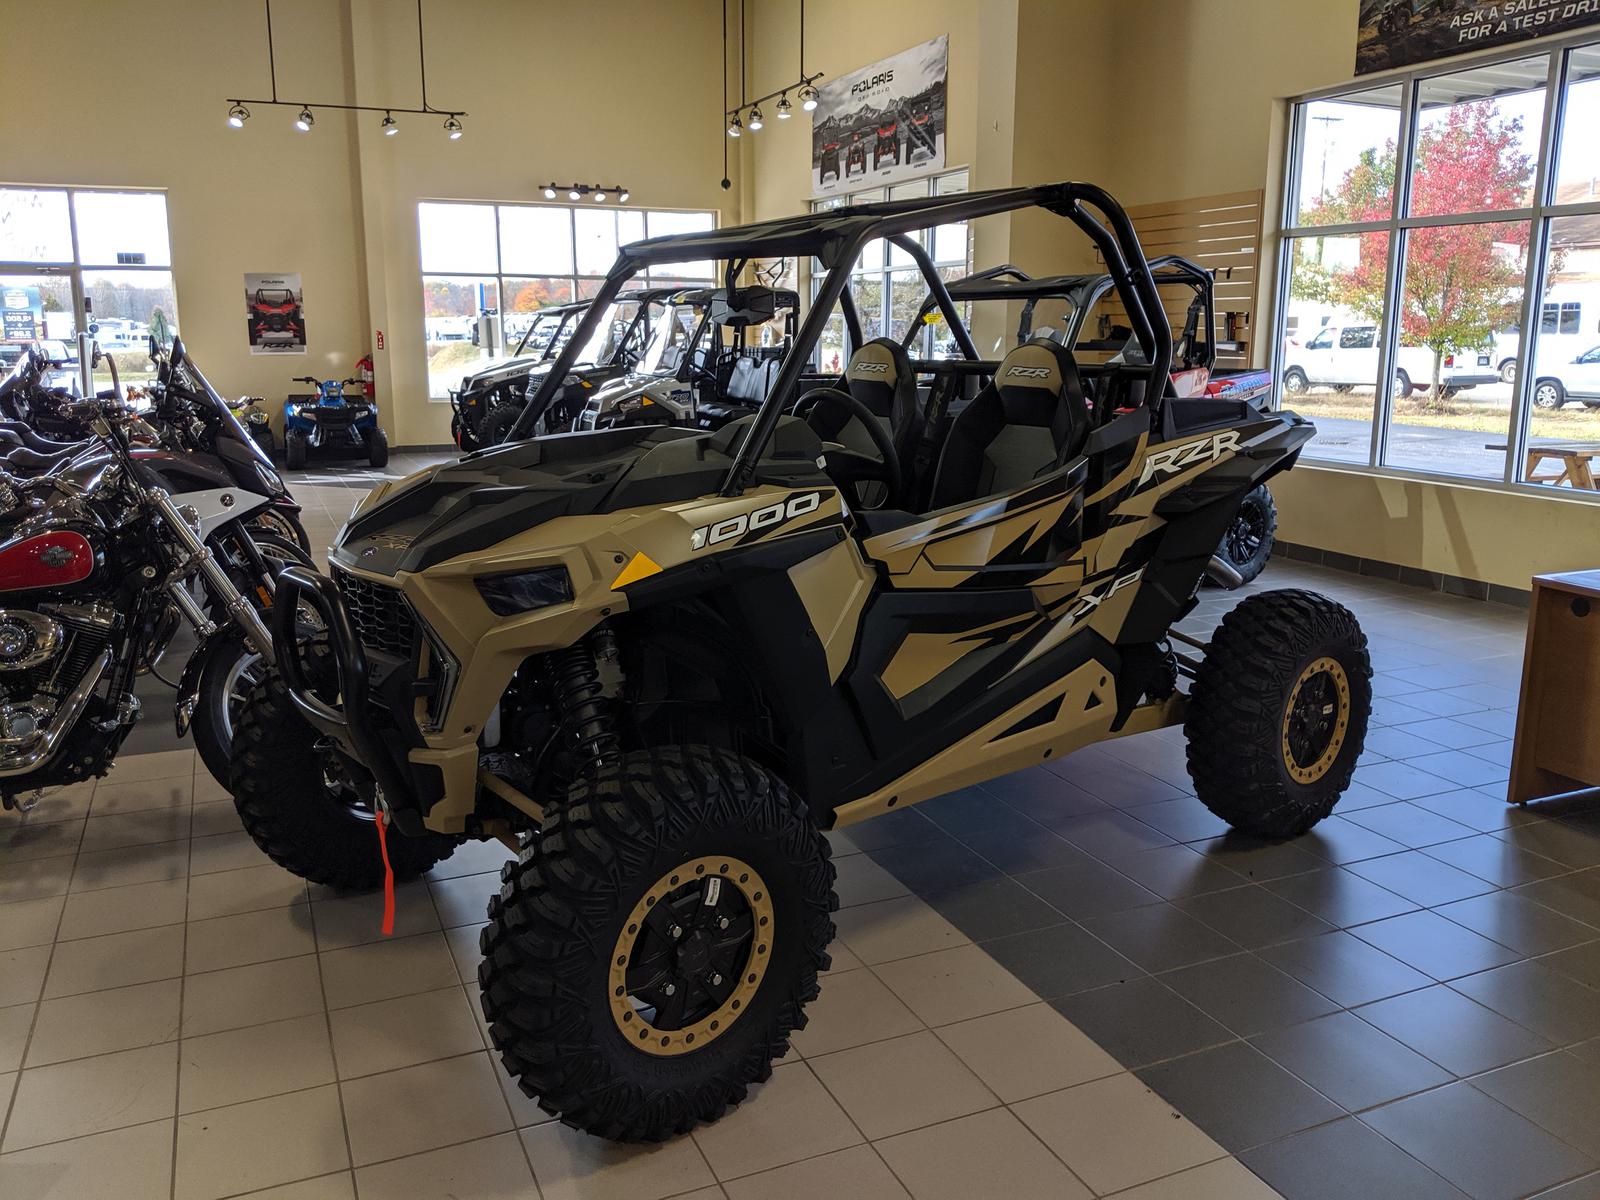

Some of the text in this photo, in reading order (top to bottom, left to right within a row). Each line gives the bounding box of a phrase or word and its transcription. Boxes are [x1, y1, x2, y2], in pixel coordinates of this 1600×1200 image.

[1450, 9, 1484, 29] ASK
[1488, 6, 1499, 21] A
[1458, 24, 1492, 43] FOR
[1494, 20, 1508, 35] A
[1512, 8, 1560, 31] TEST
[851, 69, 894, 96] POLARIS
[262, 342, 295, 350] RZR
[854, 361, 889, 374] RZR
[1006, 366, 1052, 379] RZR
[1138, 430, 1242, 487] RZR
[691, 492, 820, 551] 1000
[1073, 567, 1144, 617] XP
